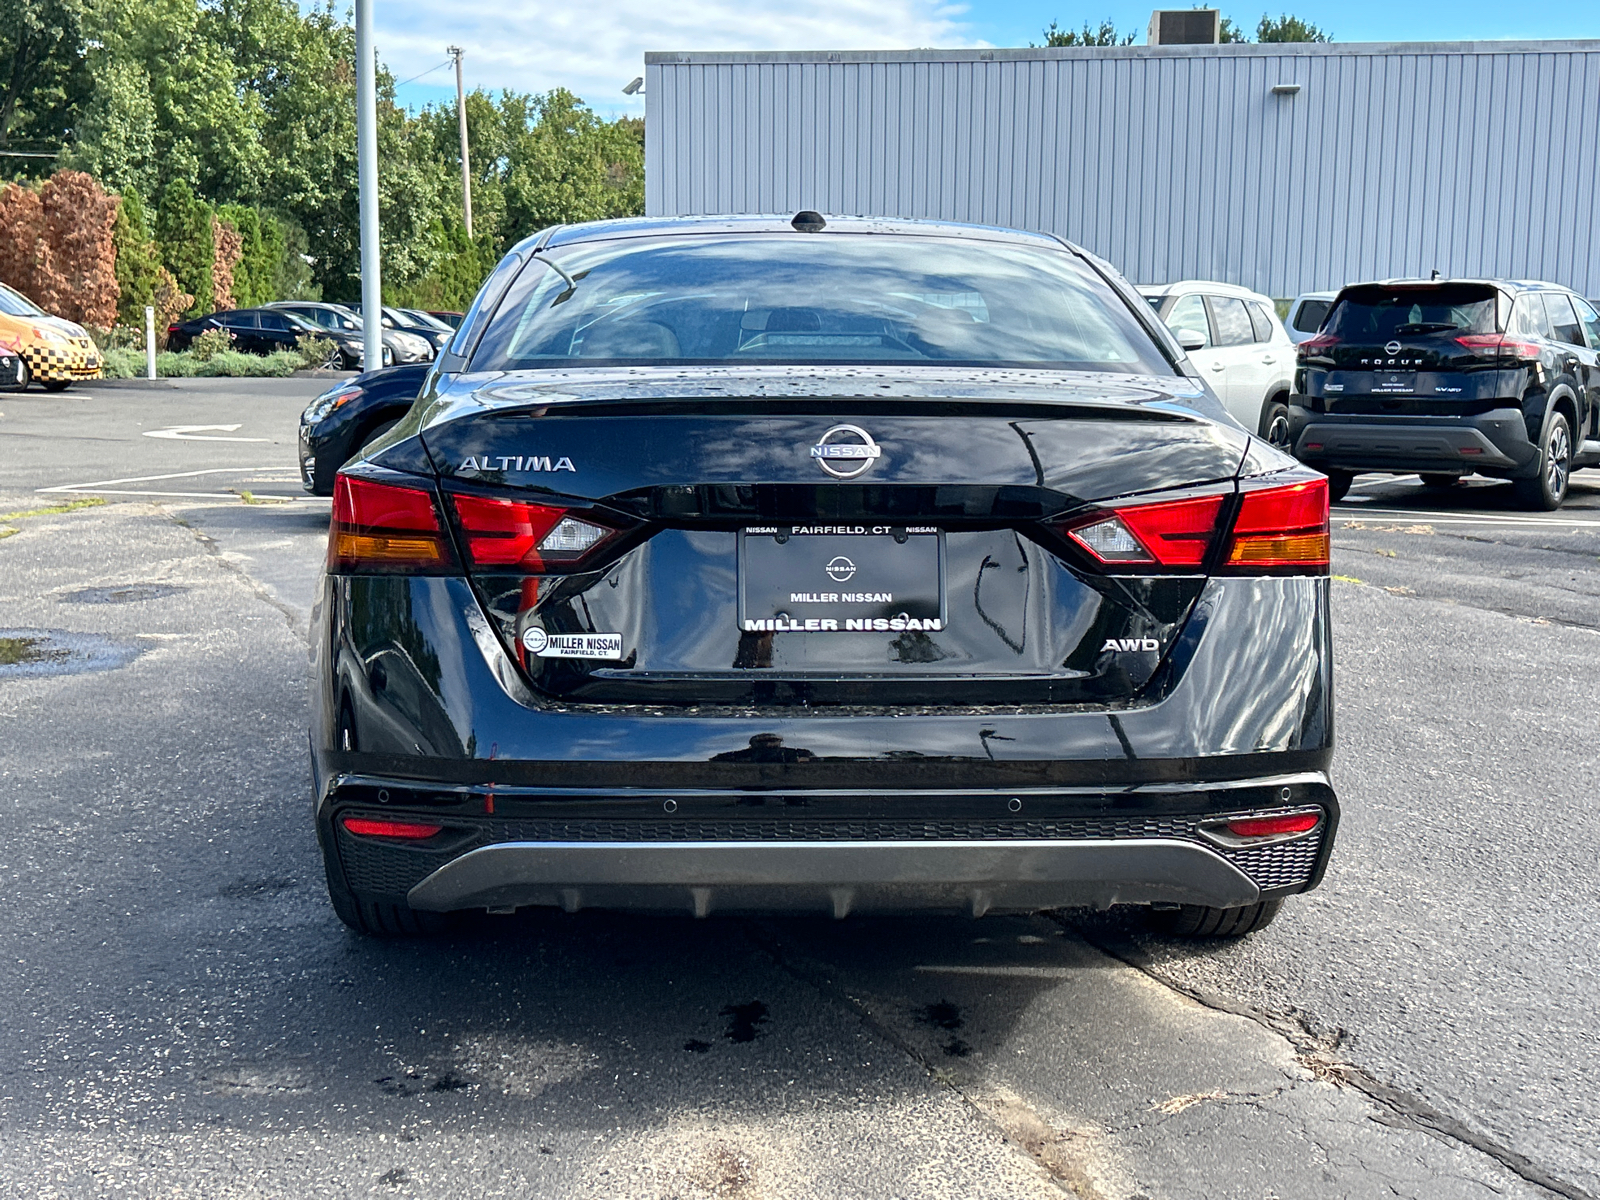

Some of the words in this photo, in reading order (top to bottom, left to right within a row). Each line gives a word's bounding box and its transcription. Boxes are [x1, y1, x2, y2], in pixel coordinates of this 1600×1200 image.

[810, 446, 880, 457] NISSAN
[458, 455, 577, 473] ALTIMA
[745, 526, 778, 534] NISSAN
[791, 525, 869, 536] FAIRFIELD,
[871, 525, 892, 535] CT
[790, 592, 839, 603] MILLER
[841, 592, 893, 603] NISSAN
[744, 618, 838, 631] MILLER
[845, 618, 942, 631] NISSAN
[549, 637, 584, 650] MILLER
[586, 638, 620, 651] NISSAN
[1100, 638, 1160, 652] AWD
[560, 649, 597, 657] FAIRFIELD,
